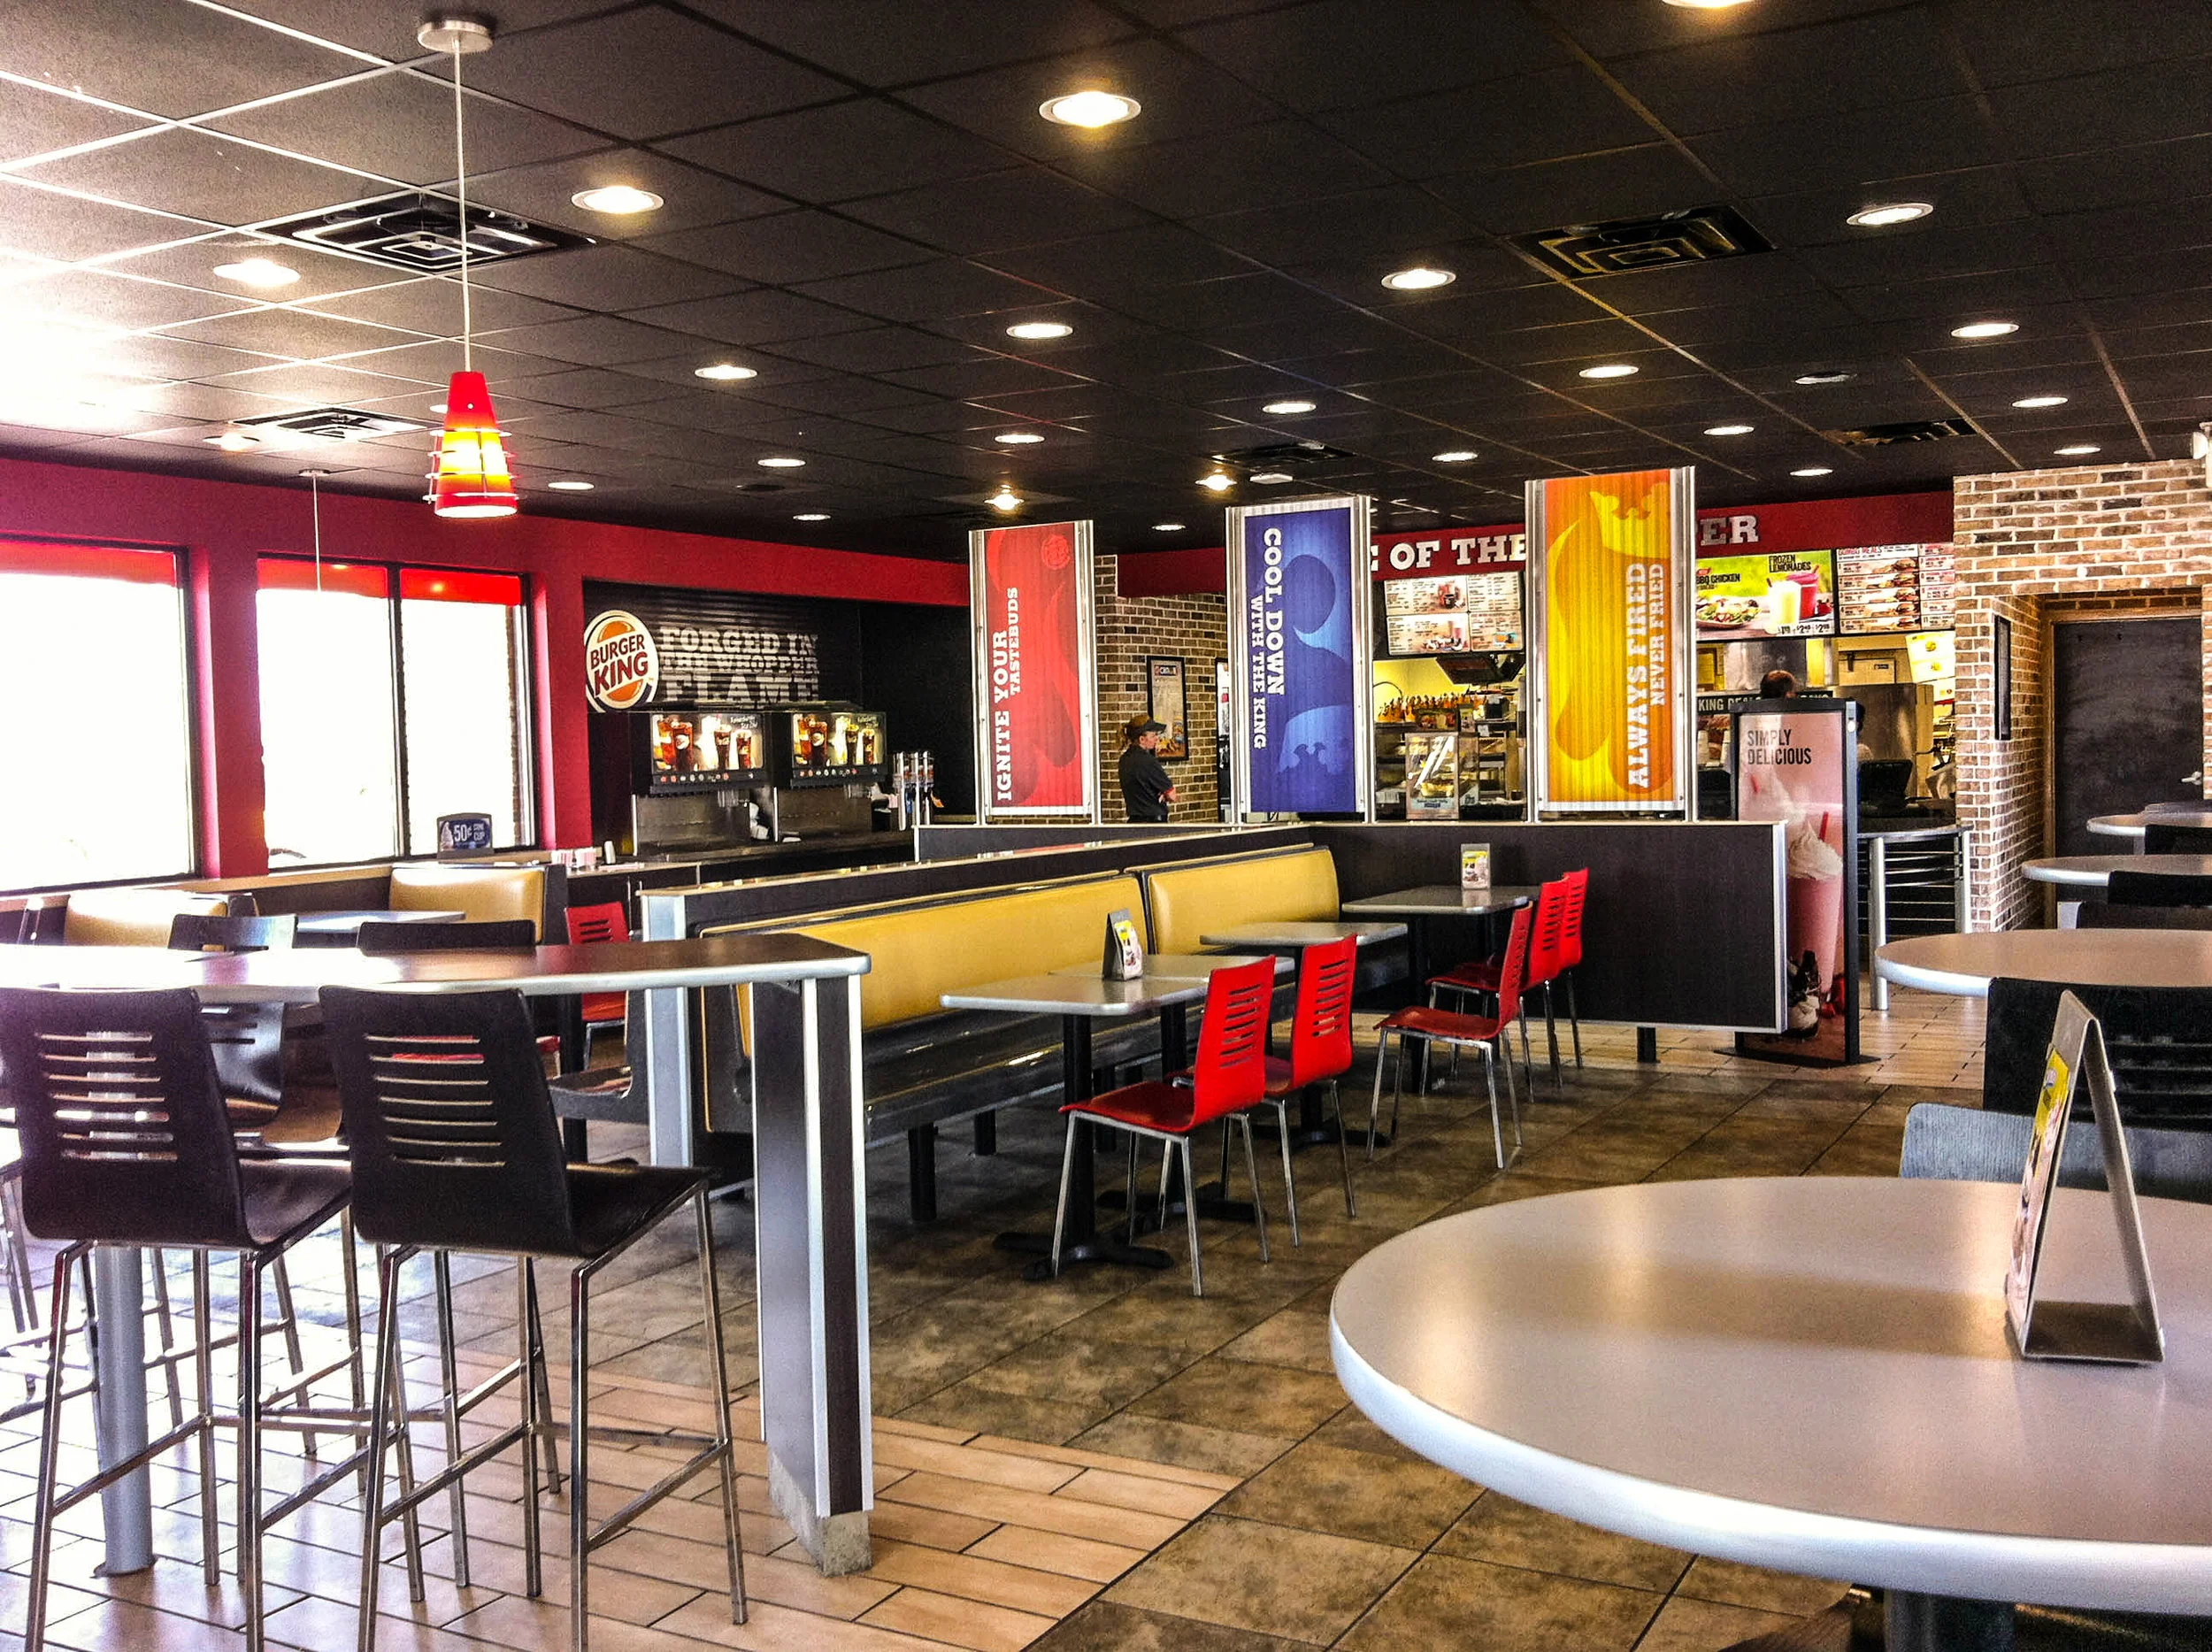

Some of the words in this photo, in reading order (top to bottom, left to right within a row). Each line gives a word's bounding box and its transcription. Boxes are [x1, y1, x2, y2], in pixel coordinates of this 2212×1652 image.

[1263, 527, 1282, 603] COOL
[1389, 540, 1440, 571] OF
[1451, 534, 1527, 565] THE
[1769, 554, 1796, 566] FROZEN
[1769, 561, 1812, 573] LEMONADES
[1649, 564, 1664, 629] FRIED
[1710, 573, 1740, 583] CHICKEN
[1250, 595, 1264, 648] WITH
[1625, 562, 1648, 655] FIRED
[590, 634, 645, 670] BURGER
[659, 626, 780, 655] FORGED
[787, 633, 819, 656] IN
[1007, 588, 1021, 695] TASTEBUDS
[1265, 610, 1286, 695] DOWN
[594, 651, 649, 696] KING
[661, 672, 819, 704] FLAME
[992, 630, 1010, 703] YOUR
[1252, 651, 1265, 693] THE
[1649, 634, 1665, 707] NEVER
[1253, 697, 1267, 749] KING
[1626, 665, 1650, 788] ALWAYS
[1698, 698, 1724, 712] KING
[995, 711, 1012, 802] IGNITE
[1747, 728, 1792, 747] SIMPLY
[1747, 748, 1812, 765] DELICIOUS
[453, 824, 472, 842] 50¢
